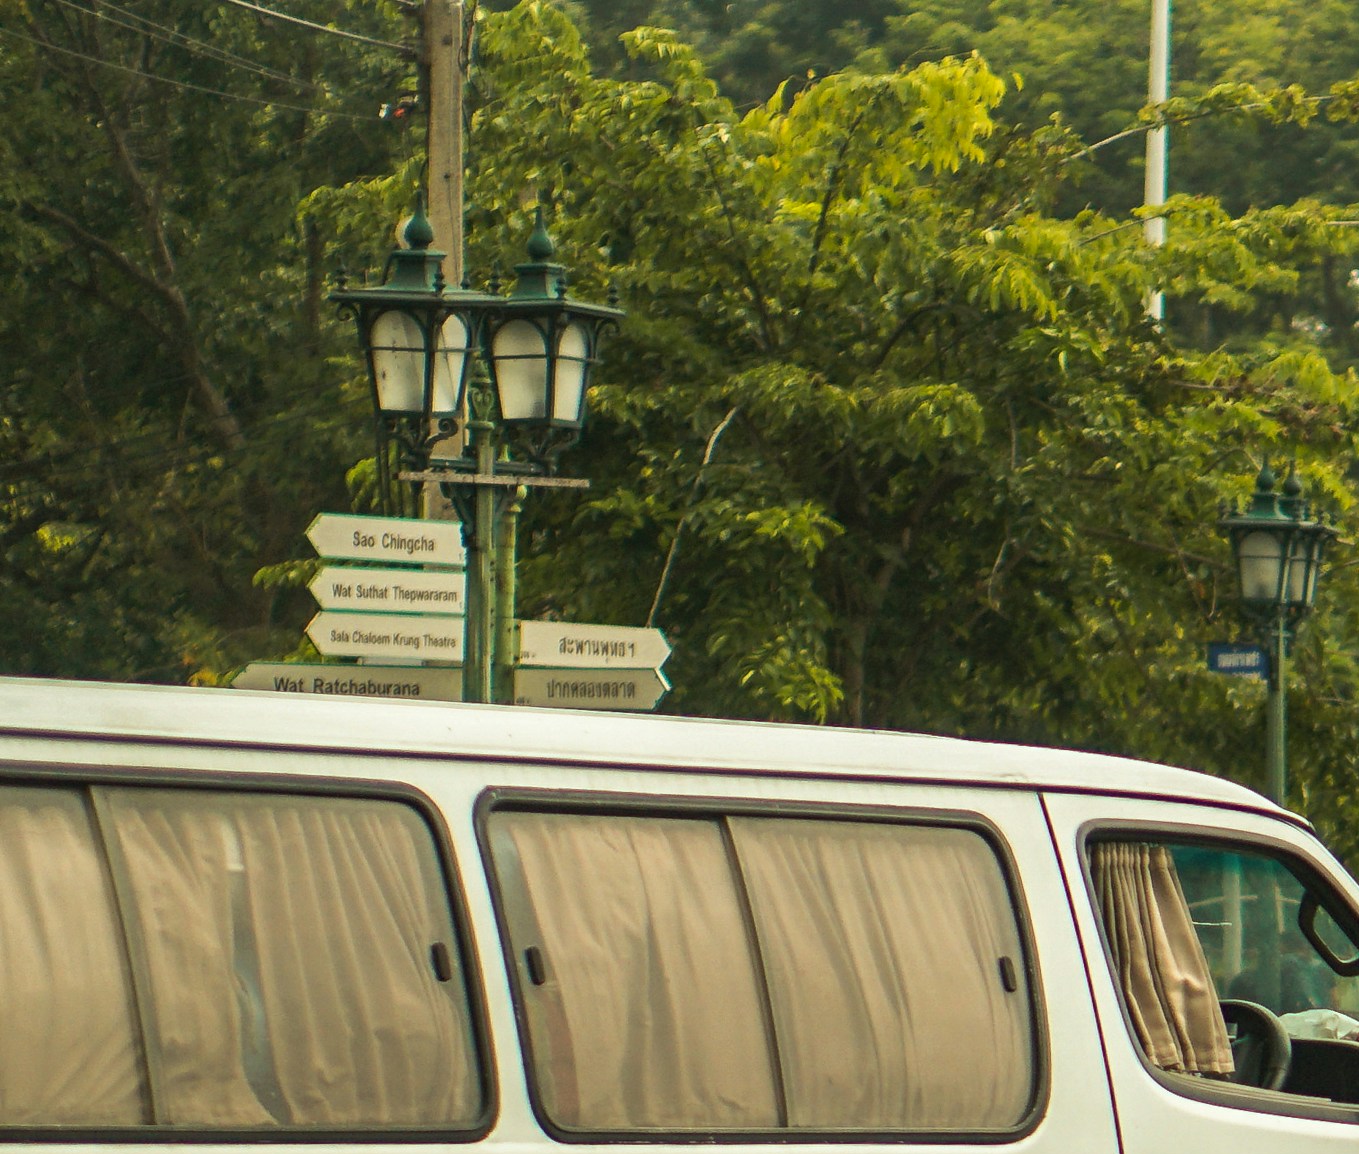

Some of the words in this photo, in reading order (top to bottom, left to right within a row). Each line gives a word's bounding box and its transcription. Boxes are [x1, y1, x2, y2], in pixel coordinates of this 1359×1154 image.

[352, 531, 375, 548] Sao
[381, 532, 435, 555] Chingcha
[332, 583, 351, 598] Wat
[355, 584, 388, 600] Suthat
[392, 586, 458, 604] Thepwararam
[330, 630, 349, 643] Sala
[352, 632, 390, 646] Chaloem
[393, 633, 419, 649] Krung
[423, 634, 457, 649] Theatre
[273, 676, 304, 693] Wat
[313, 678, 420, 696] Ratchaburana
